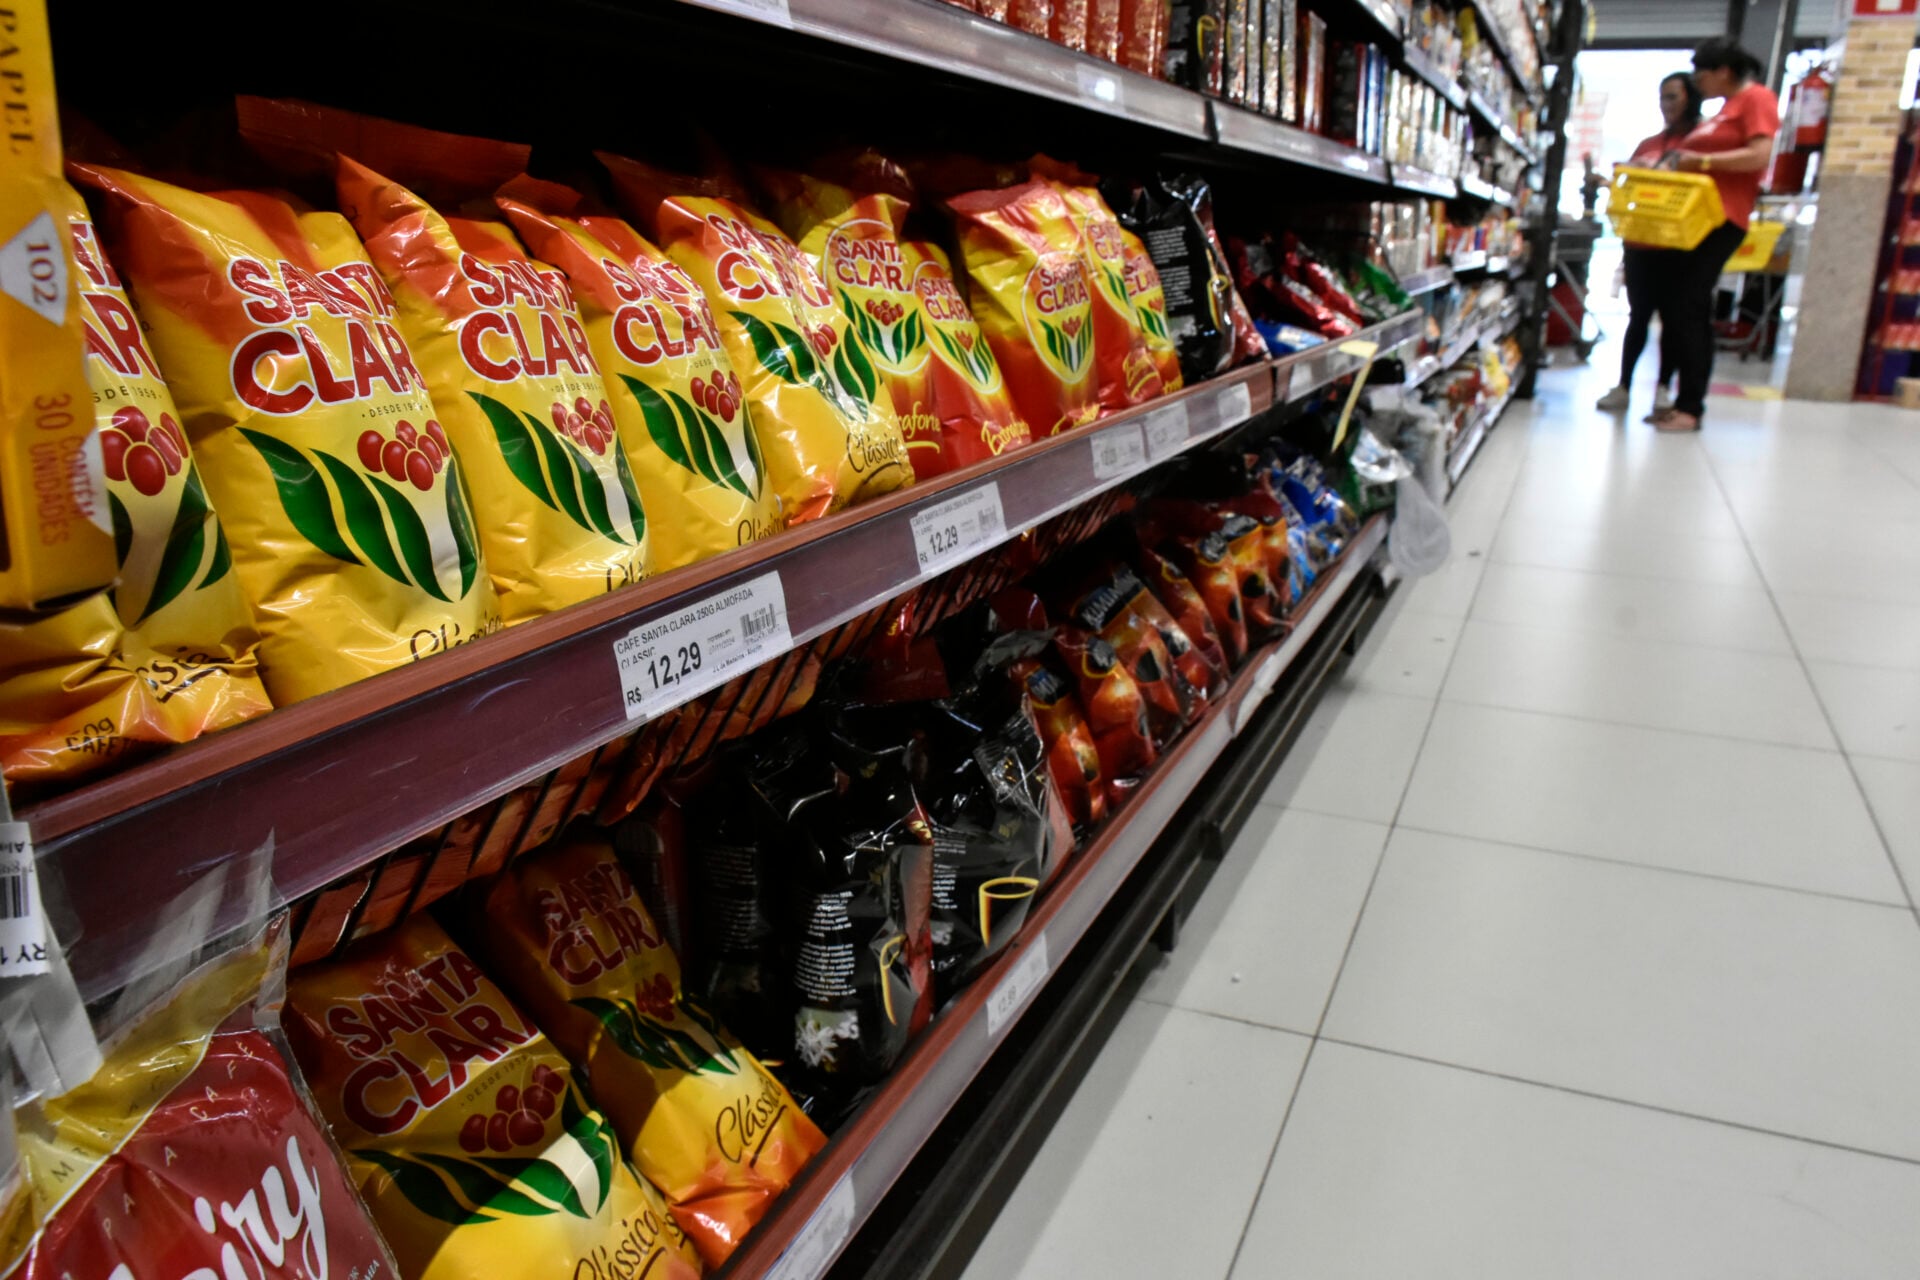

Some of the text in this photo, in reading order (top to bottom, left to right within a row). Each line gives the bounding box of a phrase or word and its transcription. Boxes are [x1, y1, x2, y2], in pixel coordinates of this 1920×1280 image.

[26, 242, 58, 305] 102
[835, 258, 913, 292] CLAR
[836, 235, 903, 263] SANT
[1036, 281, 1089, 314] CLARA
[459, 309, 602, 382] CLAR
[612, 304, 721, 366] CLAR
[230, 320, 428, 417] CLAR
[34, 393, 74, 430] 30
[929, 525, 958, 555] 12,29
[616, 588, 753, 654] CAFE SANTA CLARA 250G ALMOFADA
[626, 687, 642, 706] R$
[648, 641, 702, 689] 12,29
[547, 906, 665, 987] CLAR
[341, 1004, 541, 1137] CLAR
